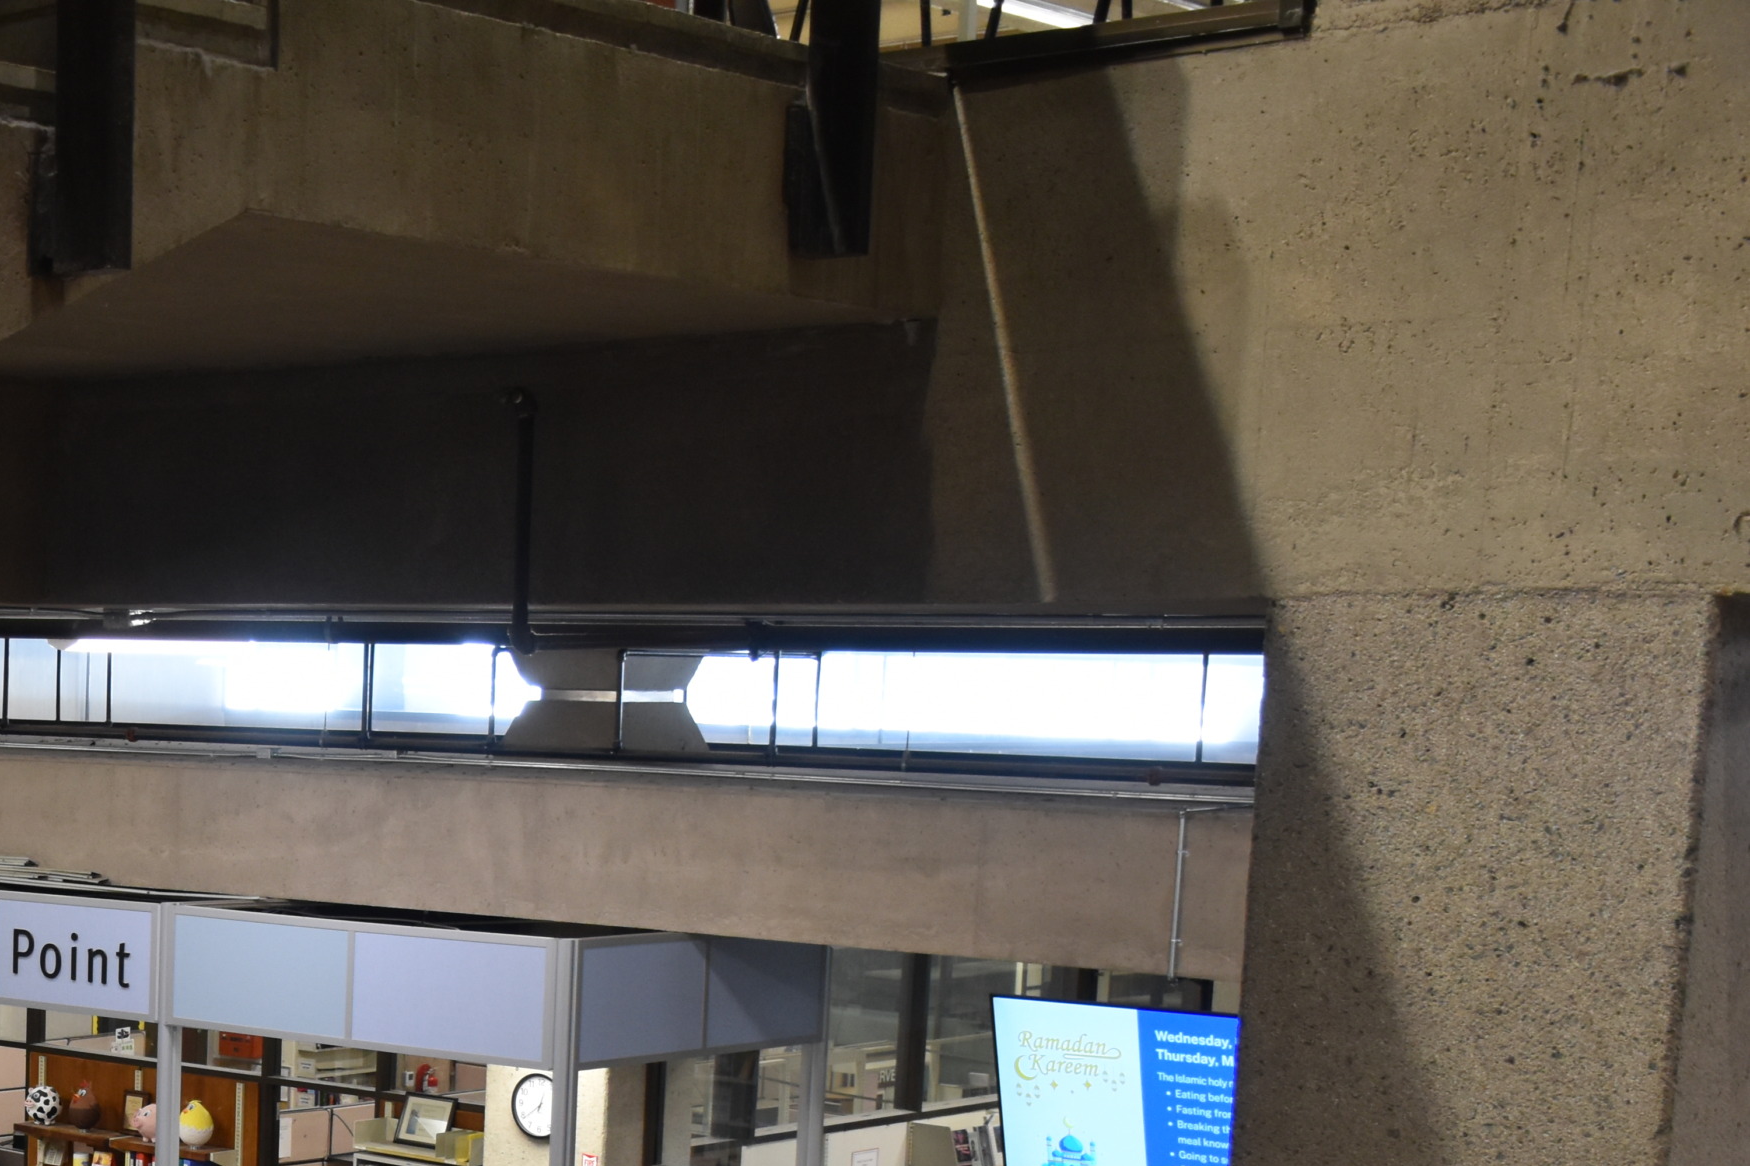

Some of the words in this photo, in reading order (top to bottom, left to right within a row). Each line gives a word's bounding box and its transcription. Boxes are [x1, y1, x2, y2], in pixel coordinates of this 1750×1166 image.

[12, 928, 130, 988] Point
[1018, 1030, 1121, 1059] Ramadan
[1155, 1030, 1232, 1049] Wednesday,
[1028, 1053, 1099, 1077] Kareem
[1155, 1048, 1219, 1067] Thursday,
[1157, 1071, 1174, 1082] The
[1175, 1074, 1207, 1085] Islamic
[1208, 1077, 1227, 1089] holy
[1175, 1089, 1206, 1103] Eating
[1176, 1105, 1211, 1118] Fasting
[1177, 1120, 1220, 1134] Breaking
[1178, 1136, 1201, 1146] meal
[1179, 1150, 1207, 1163] Going
[1209, 1155, 1219, 1163] to
